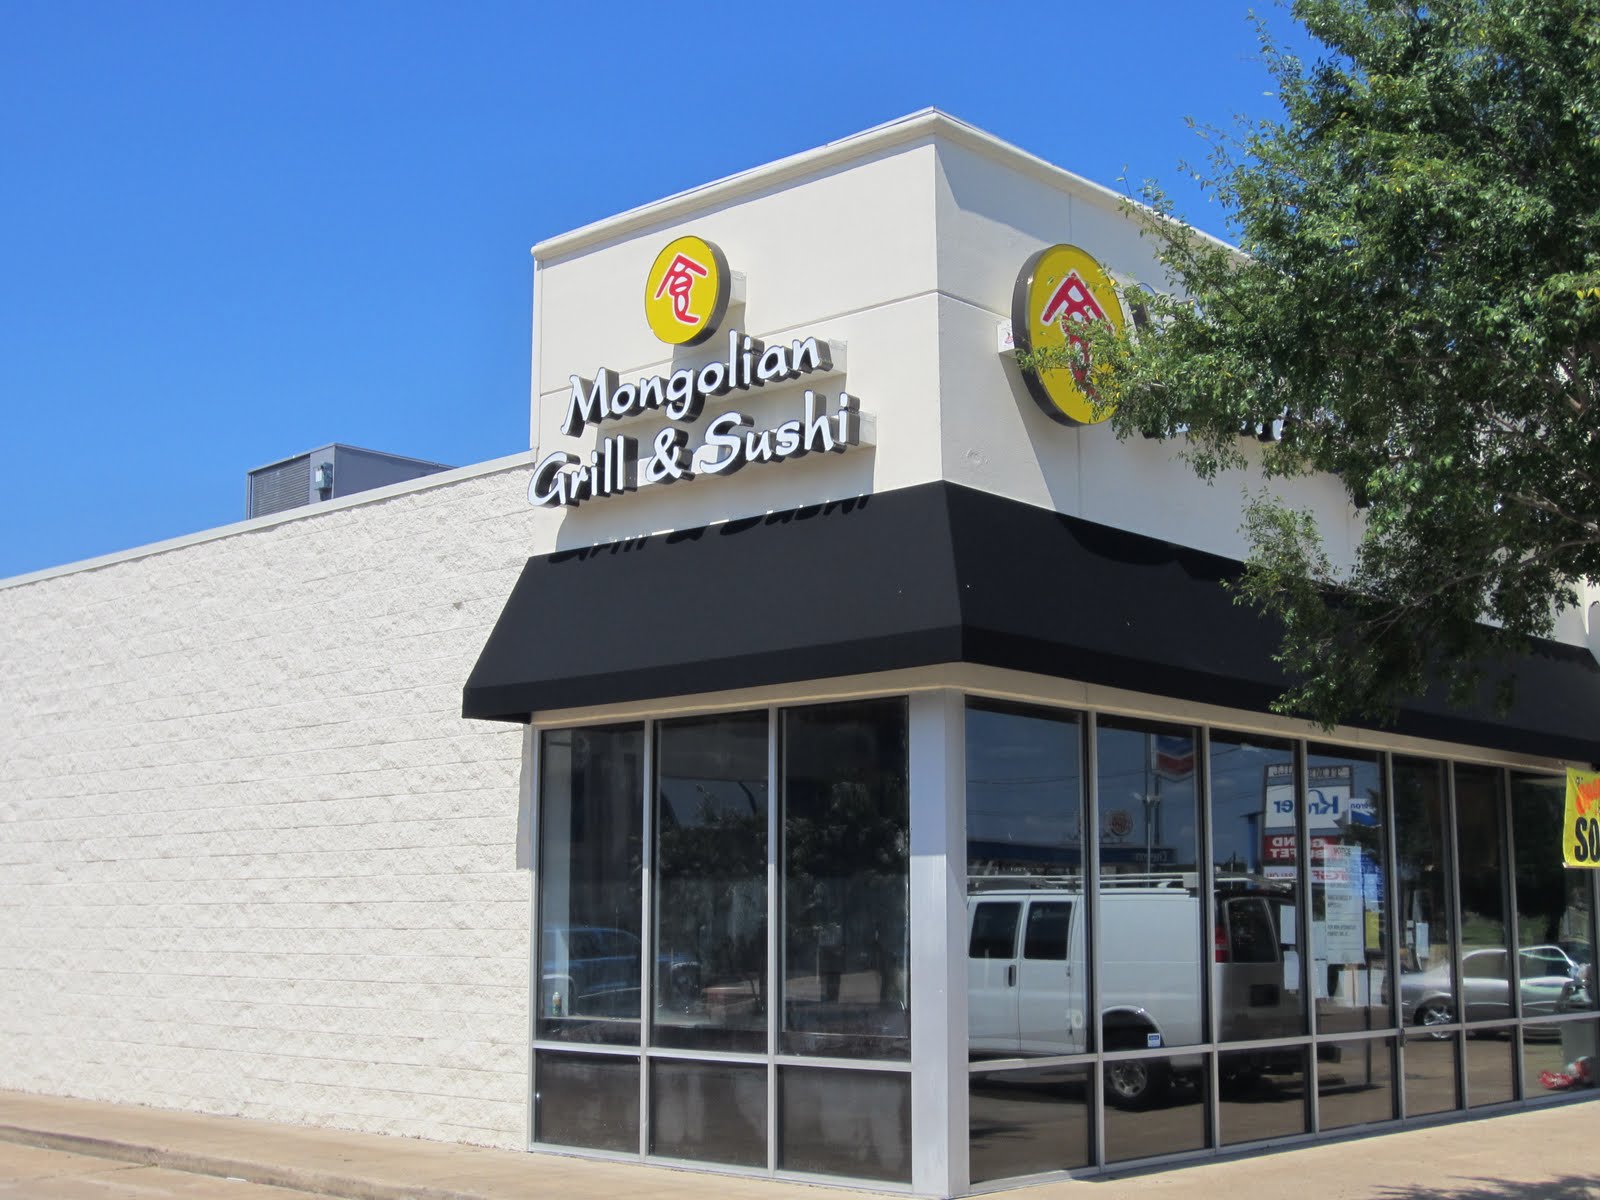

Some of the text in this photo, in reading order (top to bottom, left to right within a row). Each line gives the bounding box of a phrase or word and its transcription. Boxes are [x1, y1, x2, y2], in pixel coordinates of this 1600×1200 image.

[561, 329, 822, 436] Mongolian
[528, 389, 850, 506] Grill & Sushi
